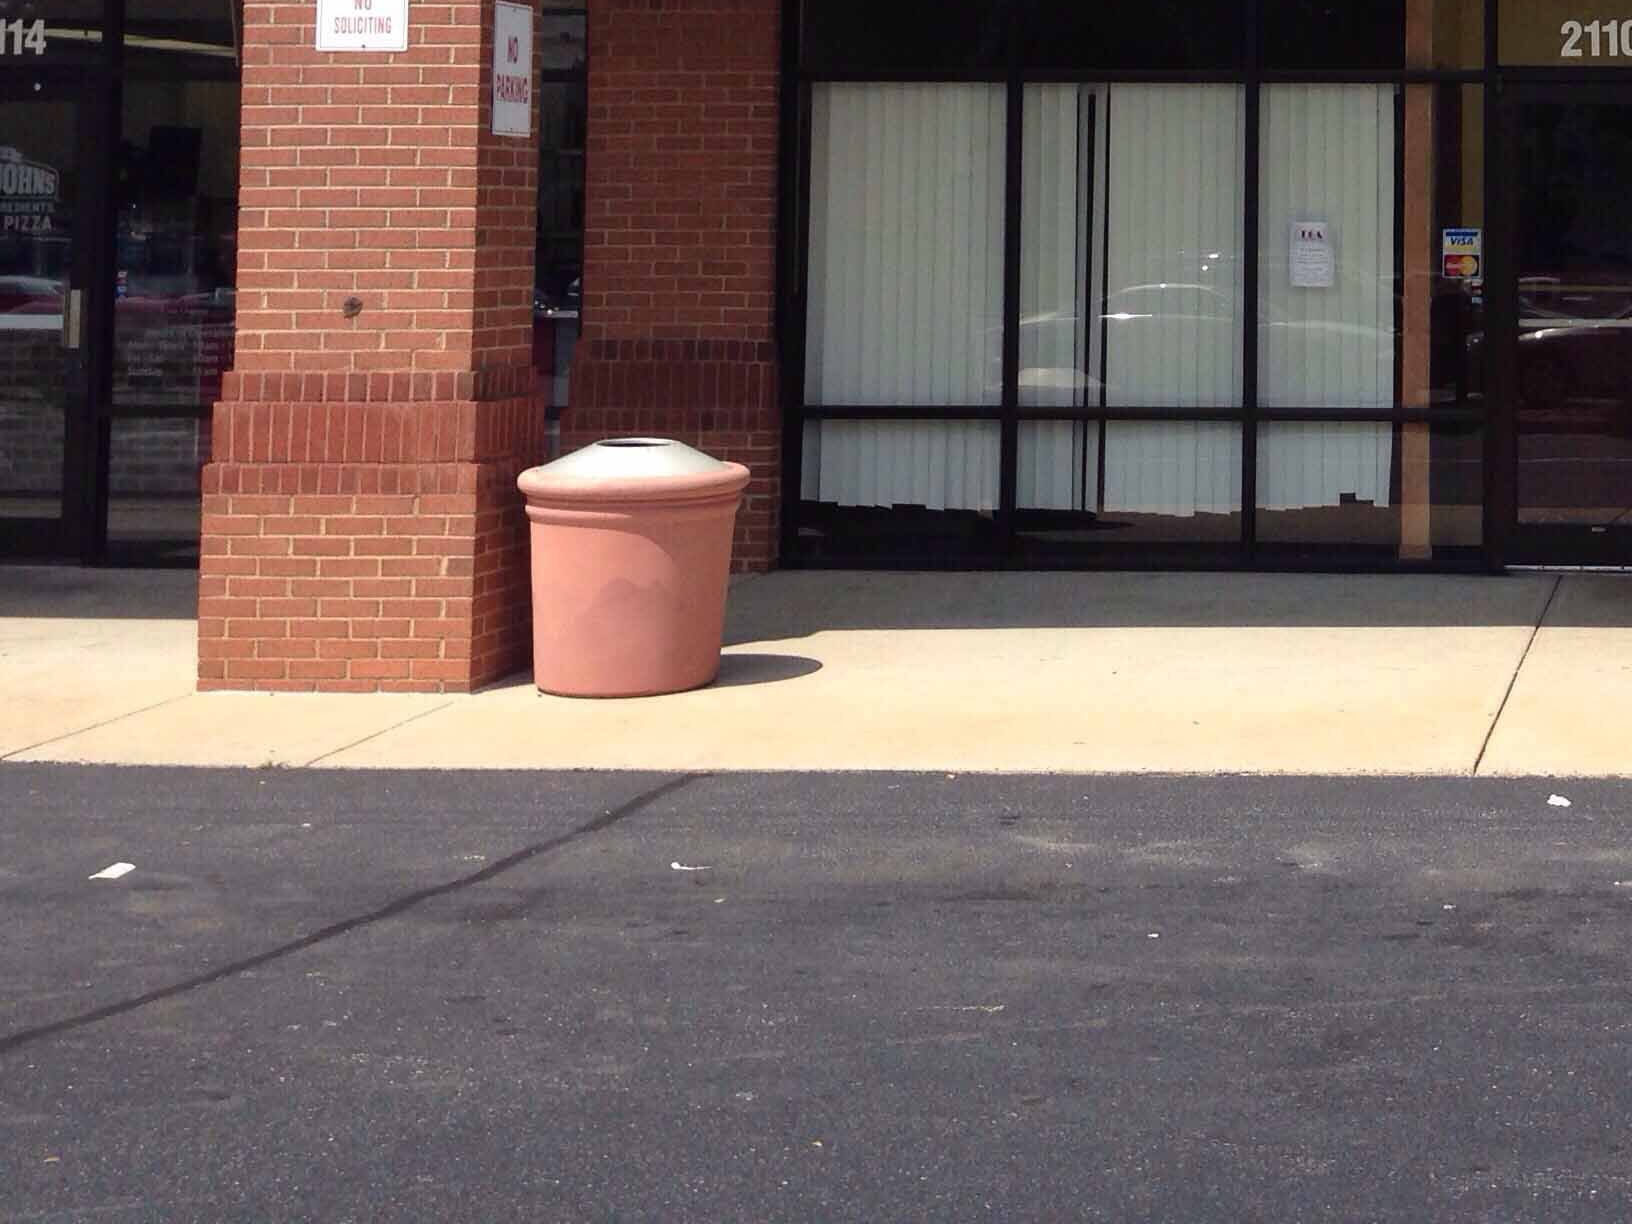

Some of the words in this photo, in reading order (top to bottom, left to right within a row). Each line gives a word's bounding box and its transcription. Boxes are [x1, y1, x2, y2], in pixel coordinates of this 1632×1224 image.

[334, 16, 392, 34] SOLICITING
[507, 35, 519, 64] NO
[496, 75, 529, 104] PARKING
[1448, 235, 1474, 246] VISA
